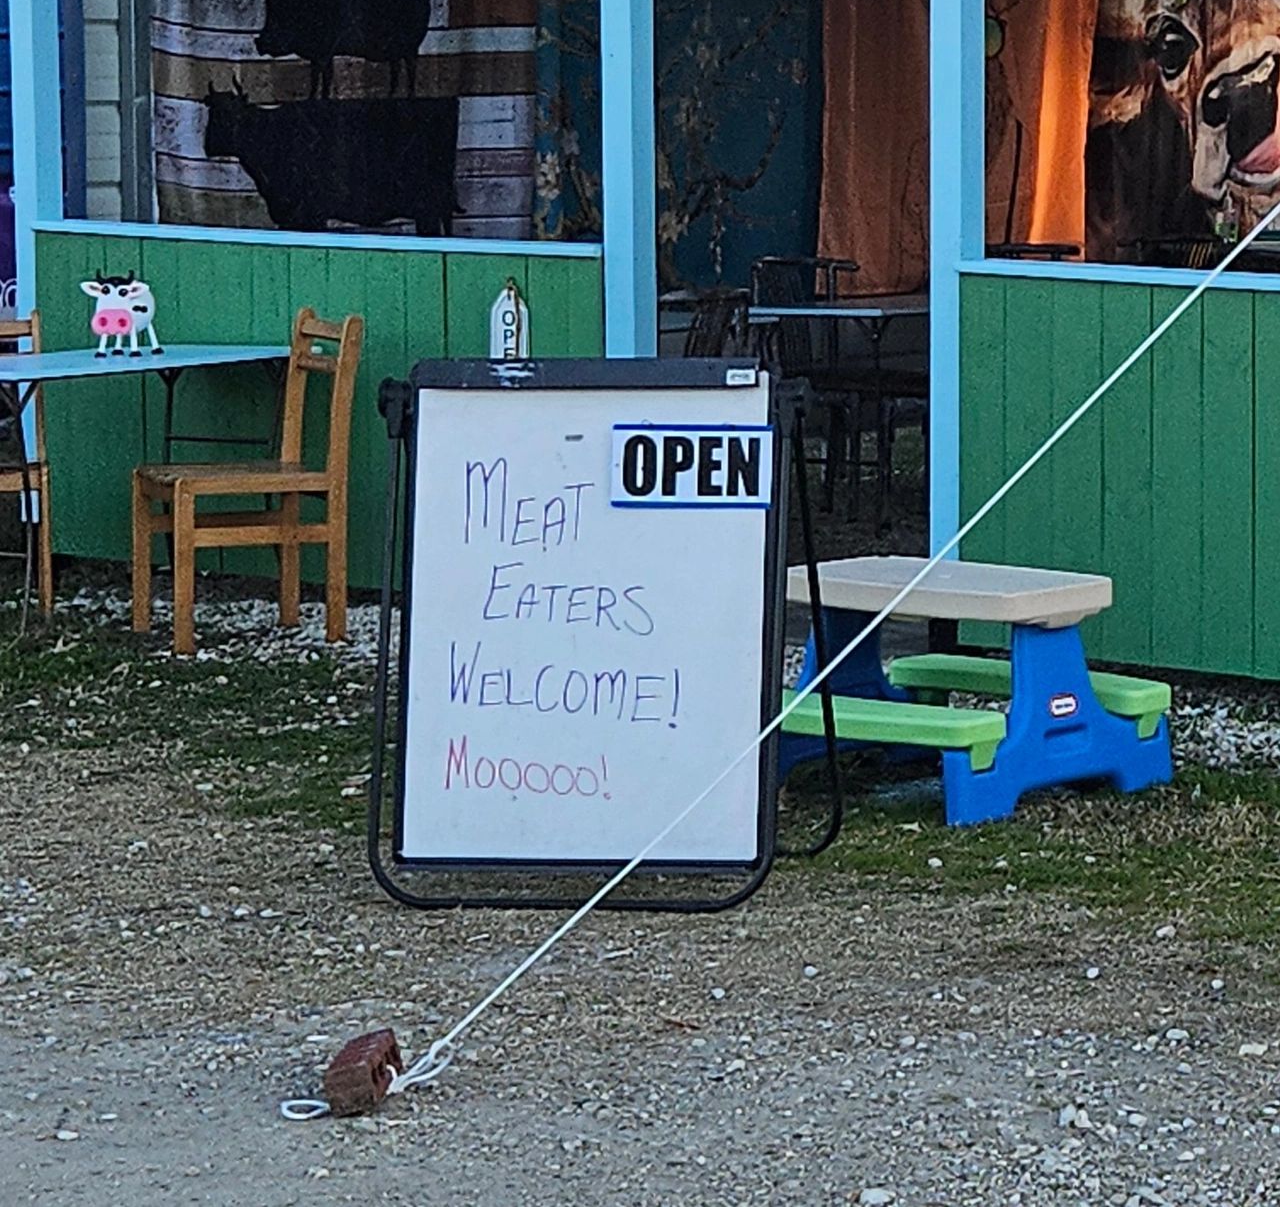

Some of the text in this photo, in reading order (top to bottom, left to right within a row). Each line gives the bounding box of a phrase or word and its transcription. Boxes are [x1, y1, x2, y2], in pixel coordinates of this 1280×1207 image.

[463, 457, 595, 553] MEAT
[621, 434, 761, 497] OPEN
[482, 562, 655, 636] EATERS
[448, 641, 682, 729] WELCOME!
